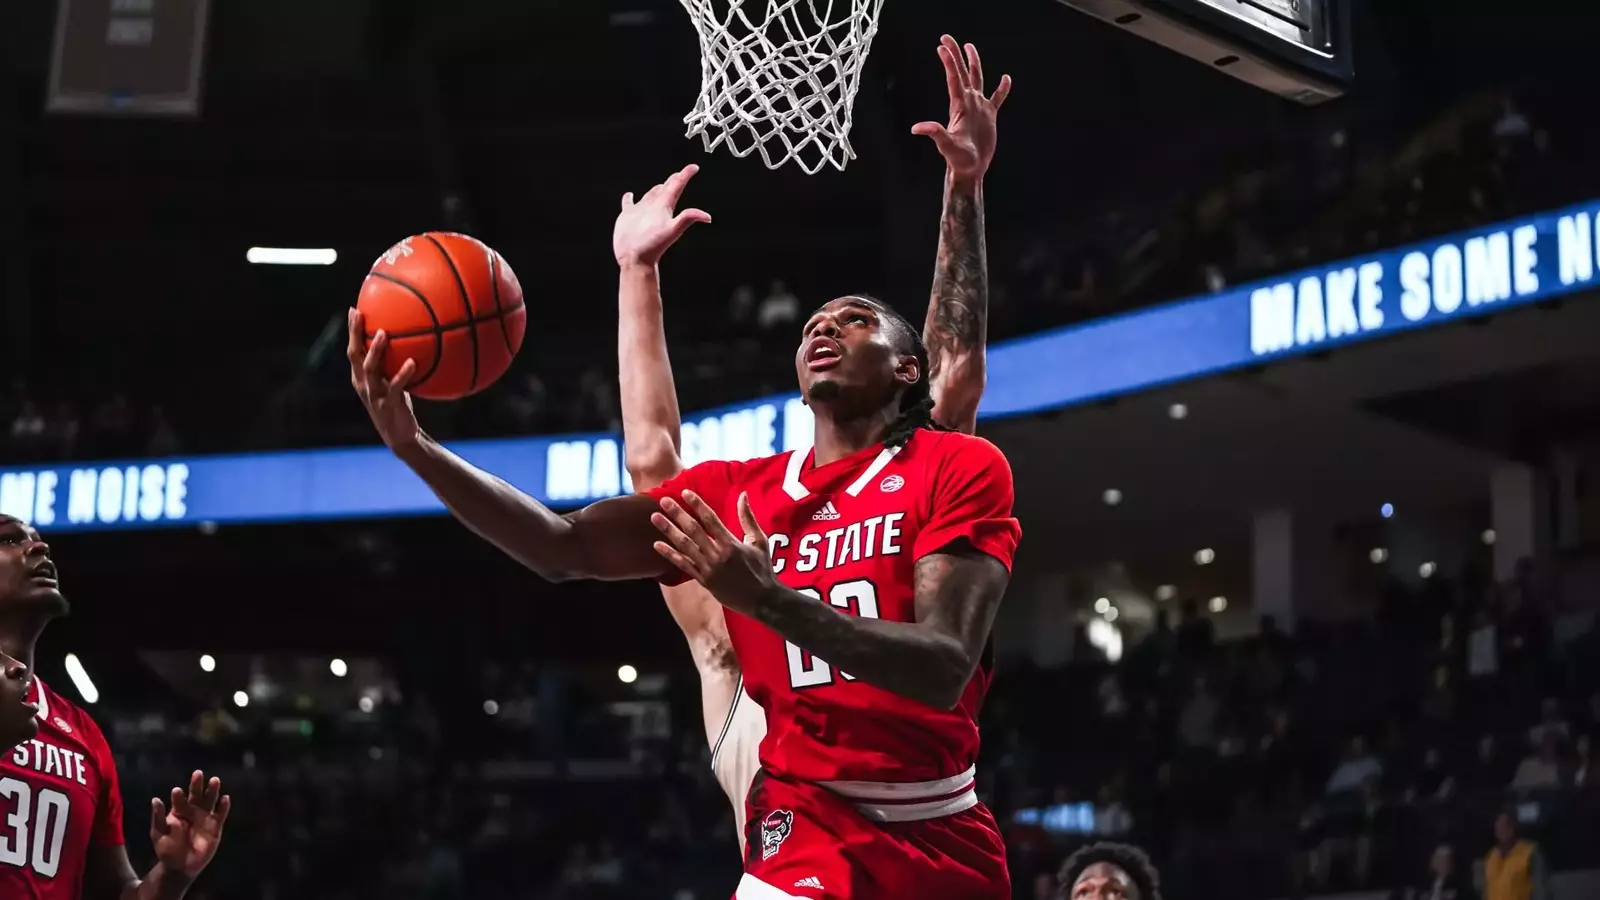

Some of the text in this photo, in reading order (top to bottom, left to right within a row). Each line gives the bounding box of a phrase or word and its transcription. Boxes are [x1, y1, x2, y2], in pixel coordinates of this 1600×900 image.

[1250, 211, 1600, 355] MAKE SOME N
[67, 463, 189, 524] NOISE
[546, 439, 634, 499] MA
[796, 512, 904, 572] STATE
[13, 739, 86, 785] STATE
[0, 777, 70, 878] 30
